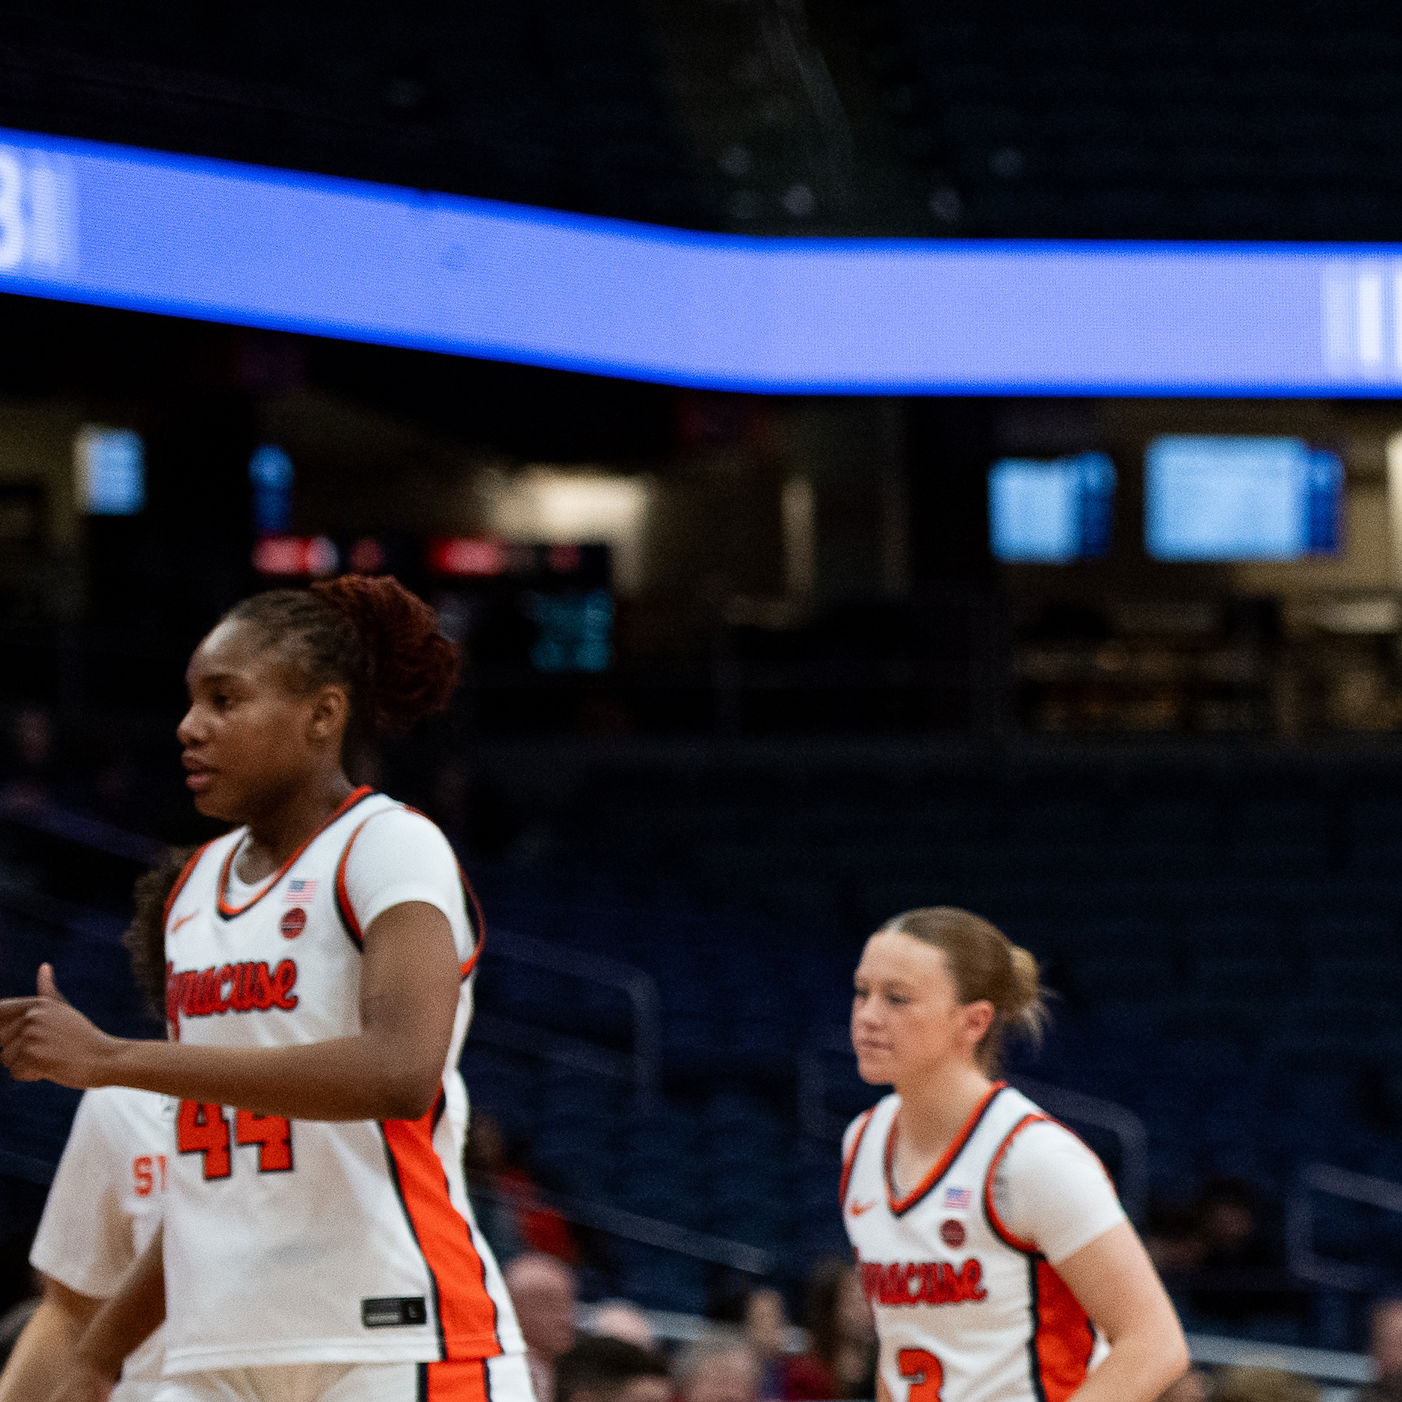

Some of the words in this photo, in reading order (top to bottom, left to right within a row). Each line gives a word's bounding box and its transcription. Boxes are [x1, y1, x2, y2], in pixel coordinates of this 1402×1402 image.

[165, 958, 299, 1042] yracuse
[177, 1098, 294, 1181] 44
[855, 1246, 988, 1306] racuse
